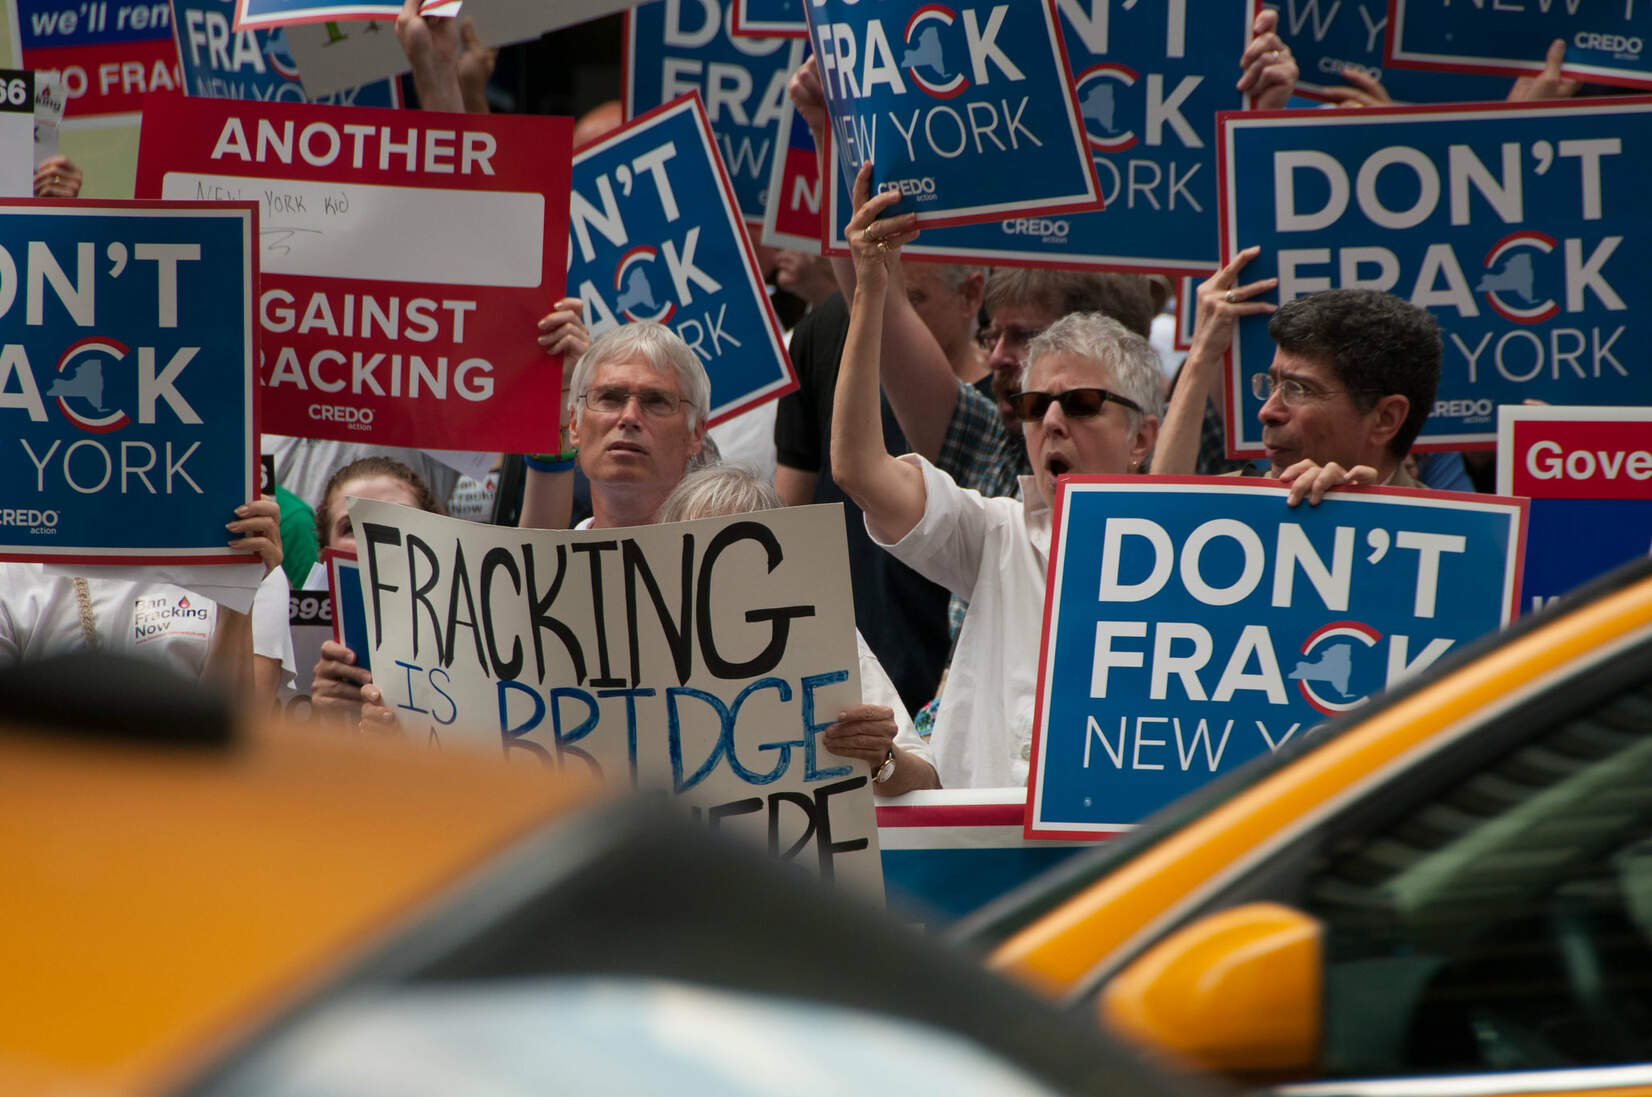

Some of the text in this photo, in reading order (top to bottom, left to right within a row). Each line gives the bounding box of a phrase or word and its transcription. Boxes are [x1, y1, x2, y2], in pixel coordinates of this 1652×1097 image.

[31, 2, 105, 36] we'll
[1574, 31, 1643, 54] CREDO
[99, 60, 181, 96] FRA
[816, 3, 1026, 100] FRACK
[210, 117, 497, 176] ANOTHER
[889, 96, 1042, 162] YORK
[264, 189, 307, 218] YORK
[1274, 137, 1622, 232] DON'T
[1001, 219, 1070, 237] CREDO
[0, 241, 201, 328] N'T
[260, 347, 495, 401] ACKING
[1451, 326, 1630, 383] YORK
[308, 403, 374, 424] CREDO
[1427, 398, 1493, 417] REDO
[20, 438, 204, 495] YORK
[1525, 440, 1652, 480] Gove
[0, 508, 59, 527] REDO
[30, 527, 57, 535] action
[1098, 517, 1467, 619] DON'T
[136, 621, 171, 639] Now
[362, 520, 816, 688] FRACKING
[394, 660, 458, 724] IS
[1089, 620, 1456, 717] FRACK
[1083, 715, 1234, 773] NEW
